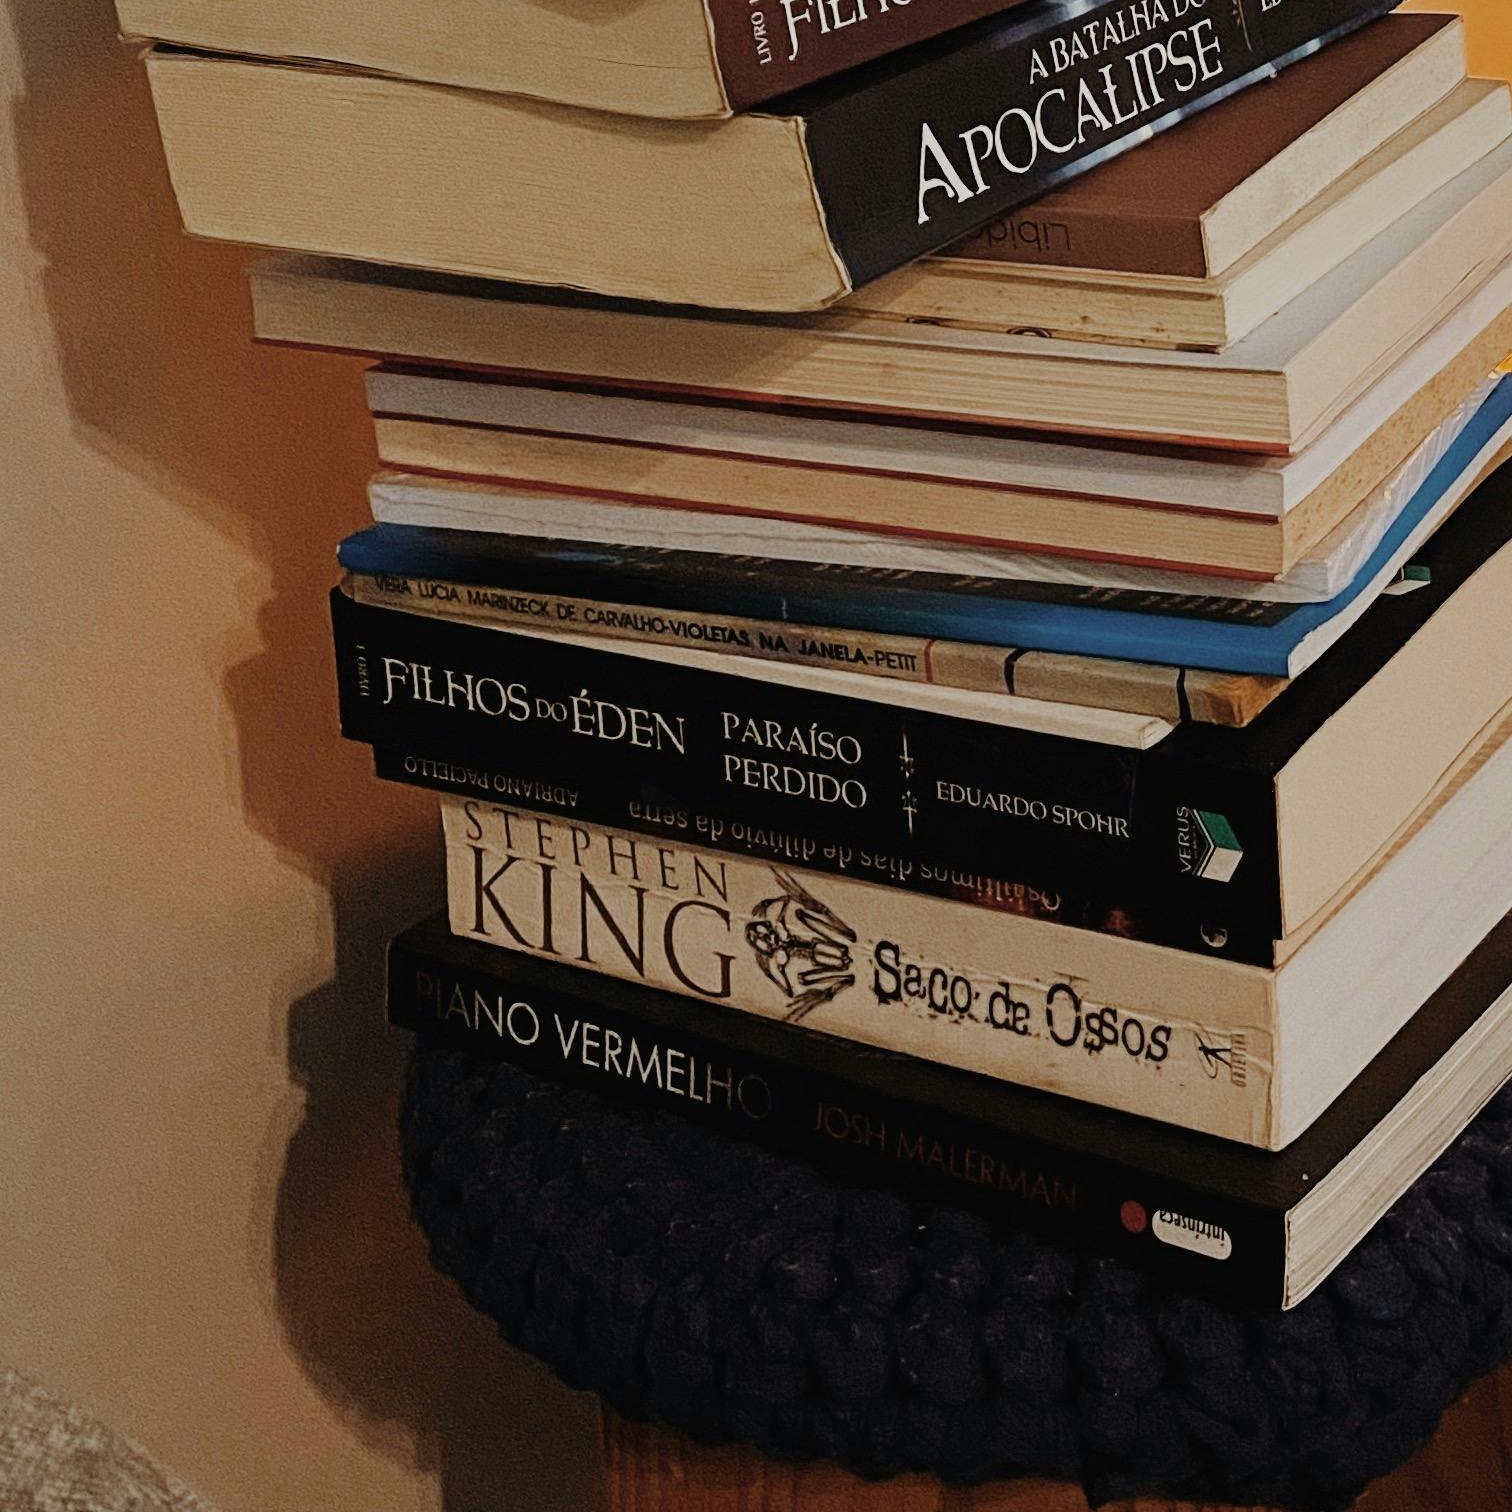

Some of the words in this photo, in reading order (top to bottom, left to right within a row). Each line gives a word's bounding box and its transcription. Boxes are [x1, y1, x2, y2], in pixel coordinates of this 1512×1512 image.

[750, 11, 772, 65] LIVRO
[1028, 47, 1048, 84] A
[917, 18, 1224, 225] APOCALIPSE
[467, 590, 548, 616] MARINZECK
[557, 603, 577, 621] DE
[759, 632, 788, 653] NA
[382, 657, 532, 723] FILHOS
[536, 697, 568, 723] DO
[571, 689, 686, 755] ÉDEN
[721, 710, 862, 764] PARAÍSO
[404, 756, 488, 789] PACIELLO
[493, 775, 578, 807] ADRIANO
[724, 754, 868, 809] PERDIDO
[629, 801, 689, 828] serra
[696, 815, 724, 841] da
[936, 781, 1047, 821] EDUARDO
[1052, 804, 1130, 838] SPOHR
[465, 800, 729, 904] STEPHEN
[731, 823, 816, 862] dilúvio
[823, 845, 852, 868] de
[861, 851, 913, 881] dias
[1177, 807, 1192, 873] VERUS
[469, 846, 735, 999] KING
[874, 940, 972, 1017] Saco
[988, 983, 1030, 1035] de
[1046, 983, 1172, 1063] Ossos
[415, 971, 539, 1046] PIANO
[554, 1013, 772, 1119] VERMELHO
[812, 1101, 886, 1152] JOSH
[896, 1133, 1077, 1211] MALERMAN
